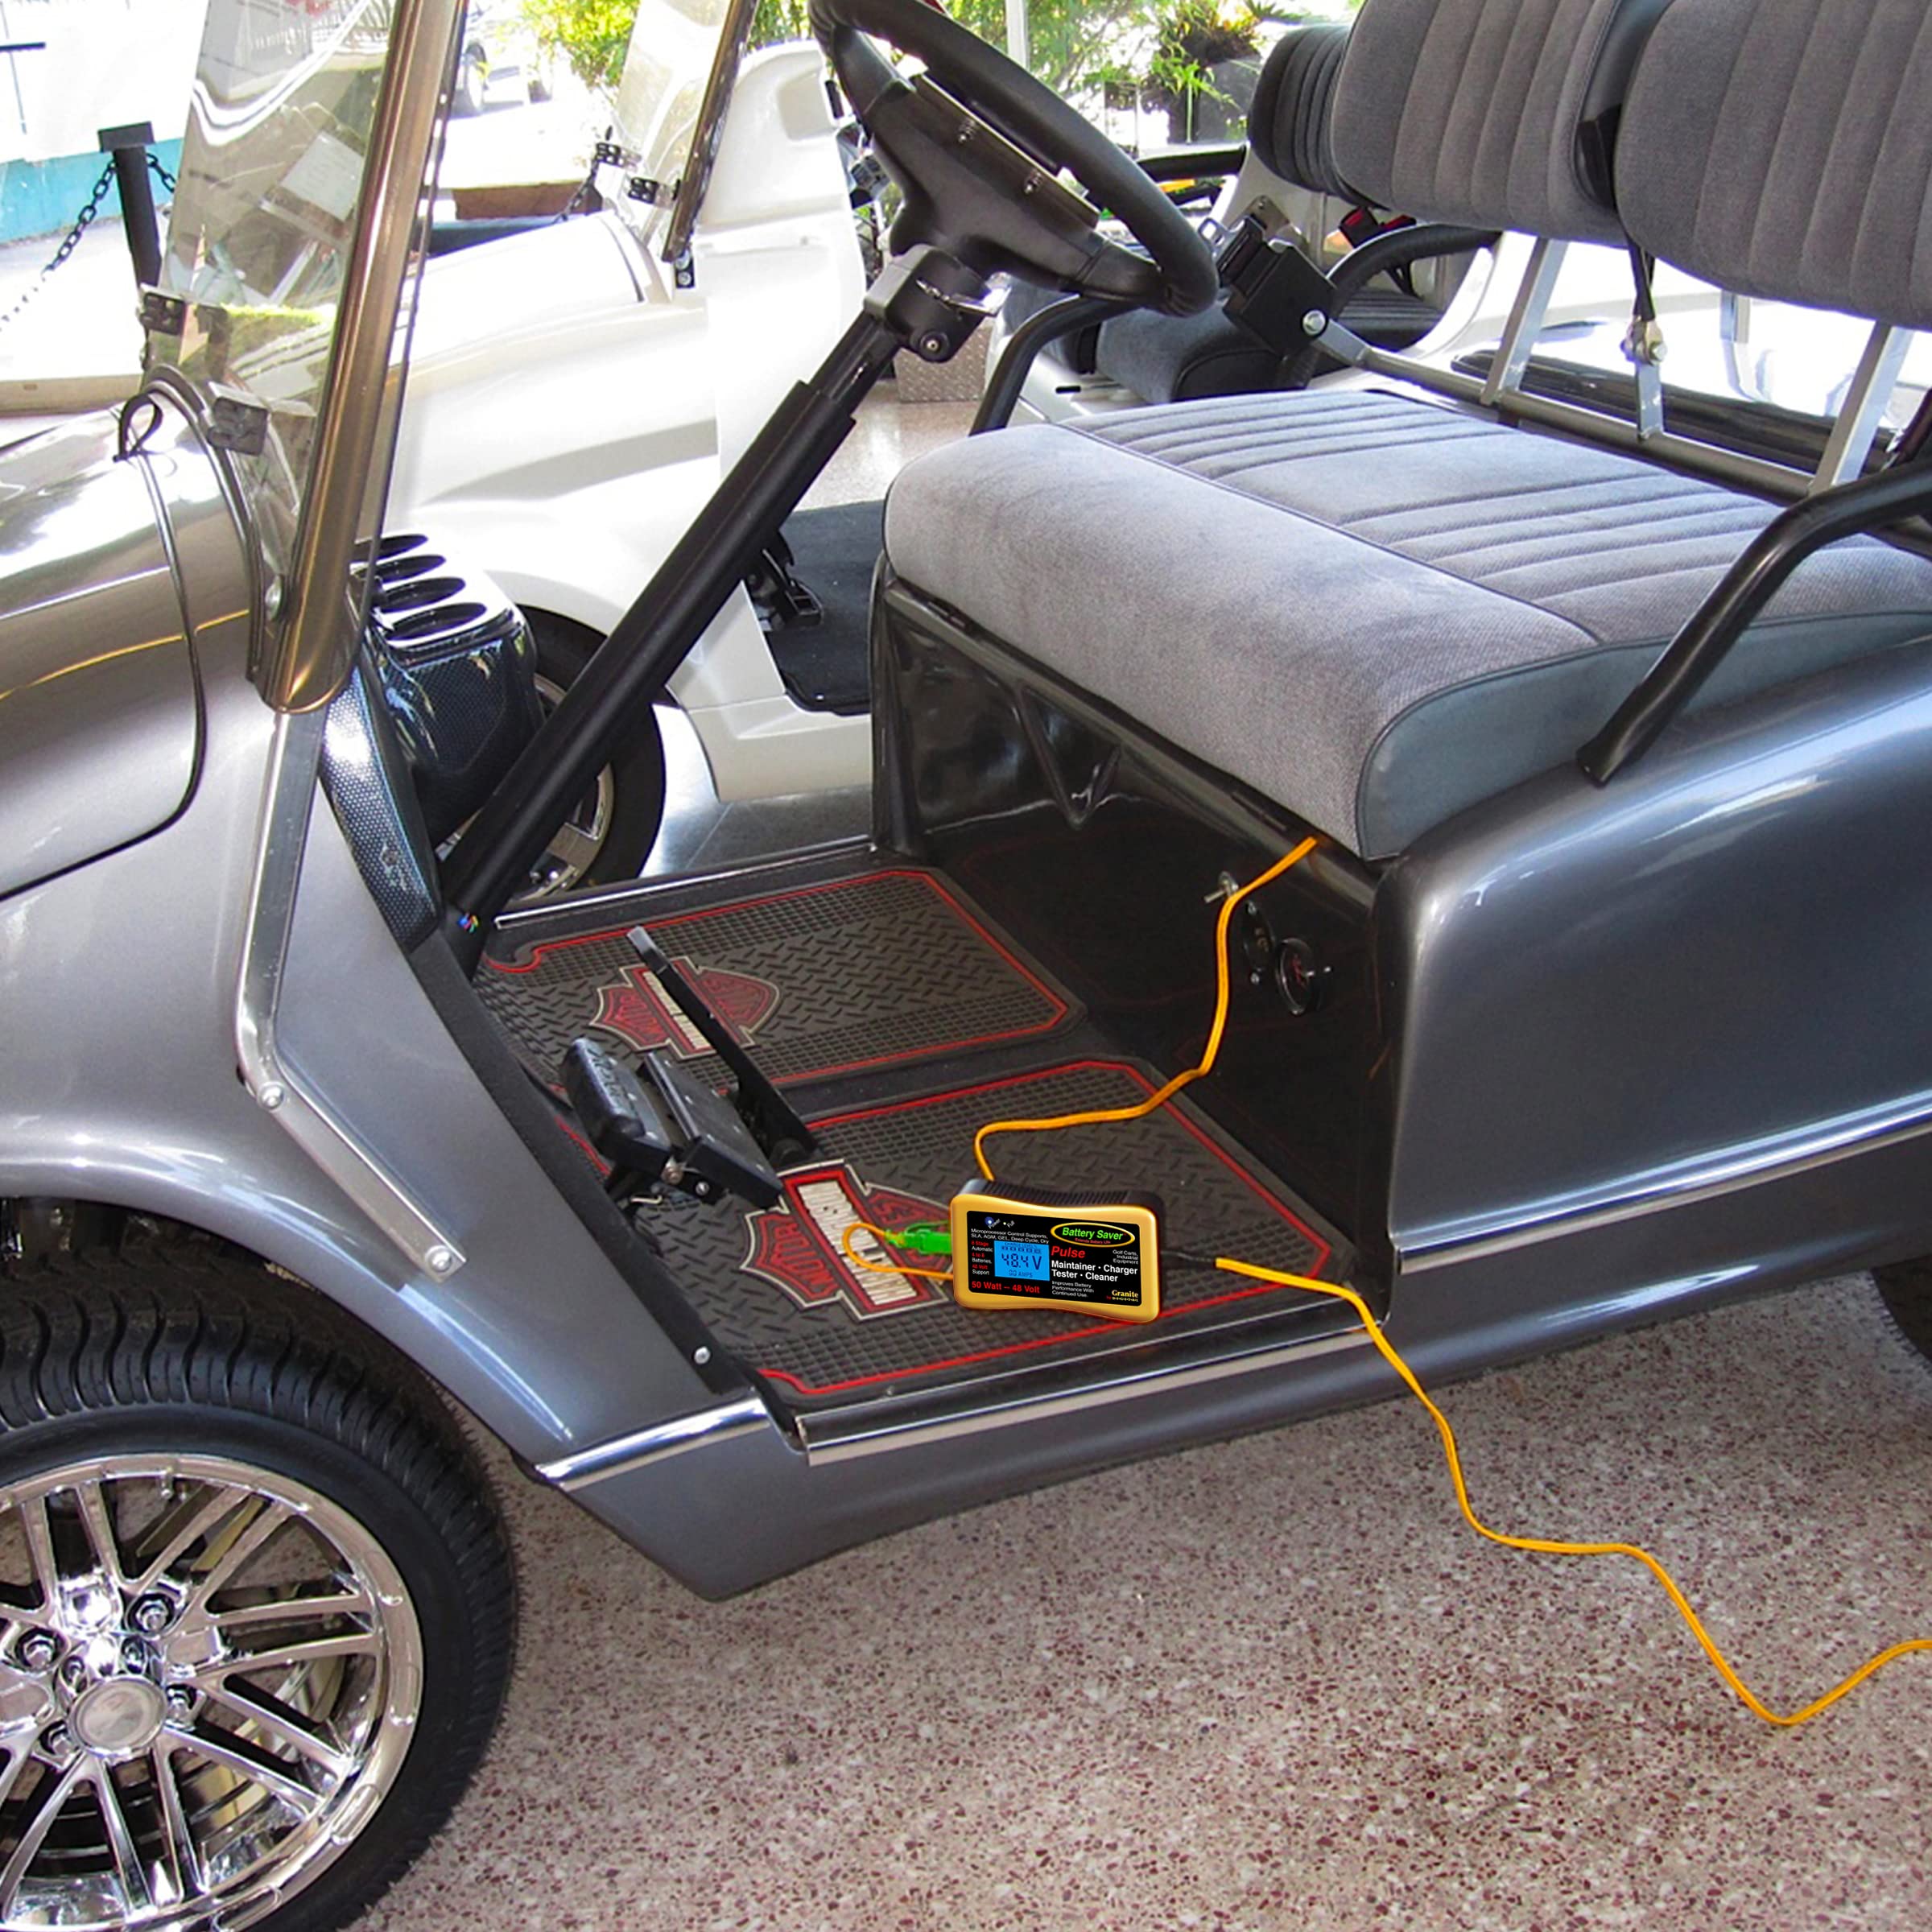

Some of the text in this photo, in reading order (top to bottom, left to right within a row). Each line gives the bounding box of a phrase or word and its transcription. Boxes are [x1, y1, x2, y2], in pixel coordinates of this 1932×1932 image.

[1063, 1228, 1123, 1240] Battery Saver
[1051, 1246, 1086, 1258] Pulse
[1001, 1253, 1042, 1270] 48.4 V
[1051, 1260, 1138, 1276] Maintainer Charger
[1051, 1269, 1118, 1282] Tester Cleaner
[983, 1282, 1002, 1290] Watt
[1024, 1285, 1040, 1294] Volt
[1112, 1290, 1139, 1298] Granite
